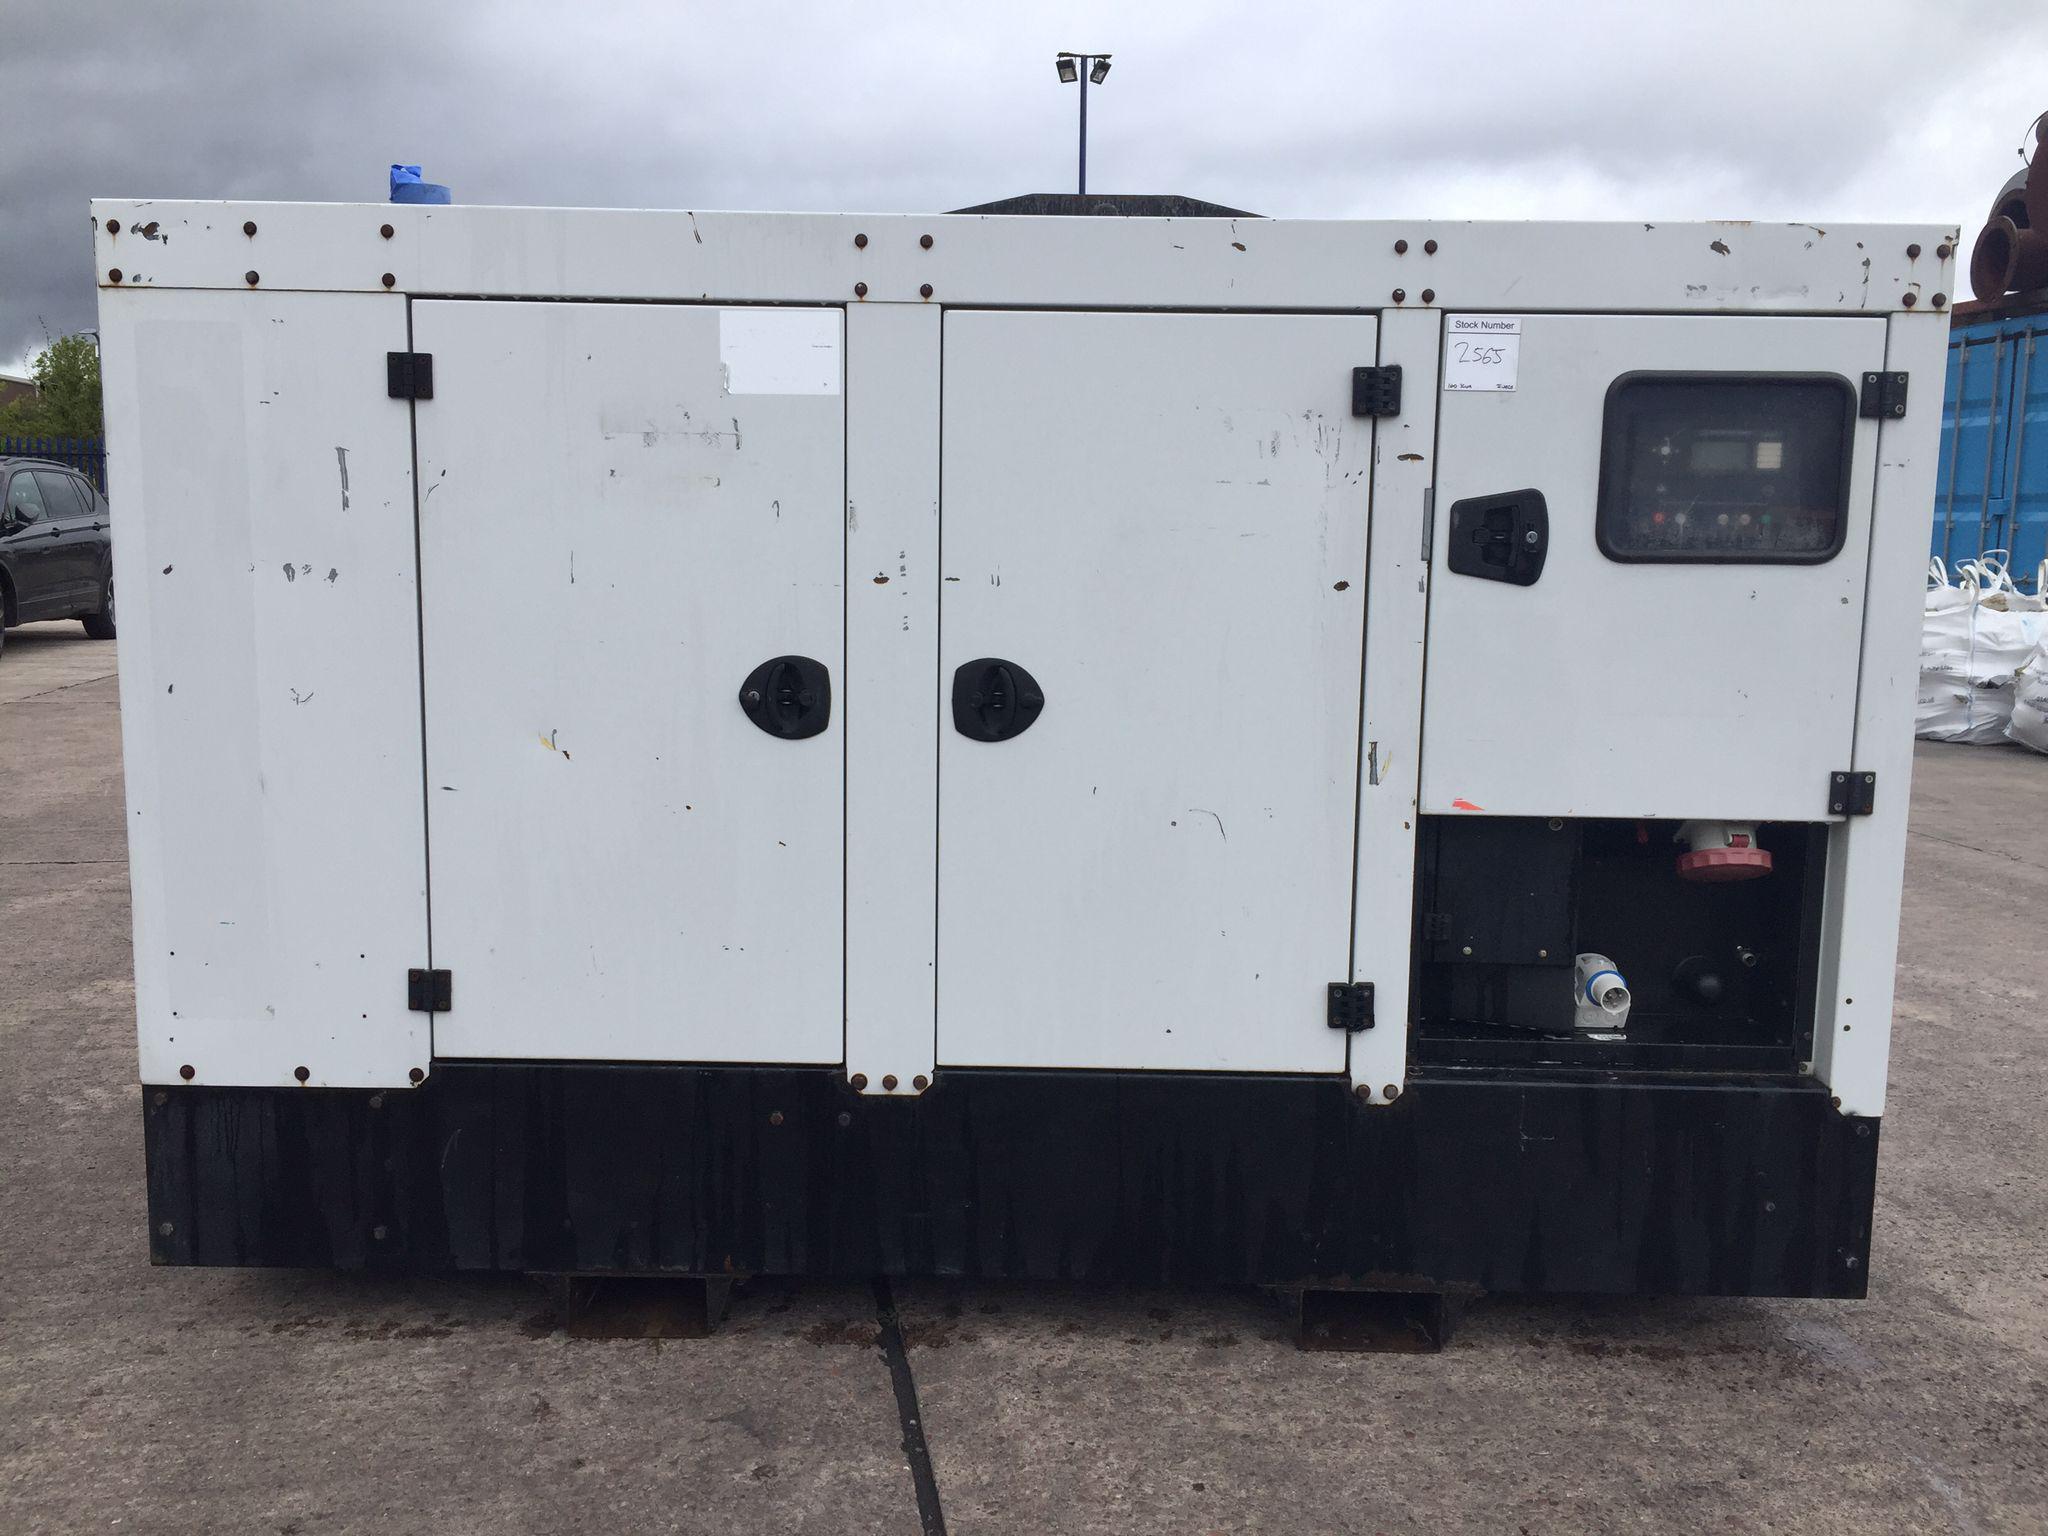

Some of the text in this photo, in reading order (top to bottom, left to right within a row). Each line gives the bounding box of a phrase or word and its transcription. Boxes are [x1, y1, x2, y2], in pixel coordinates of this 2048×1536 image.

[1455, 320, 1515, 330] Stock Number
[1454, 341, 1506, 364] 2565
